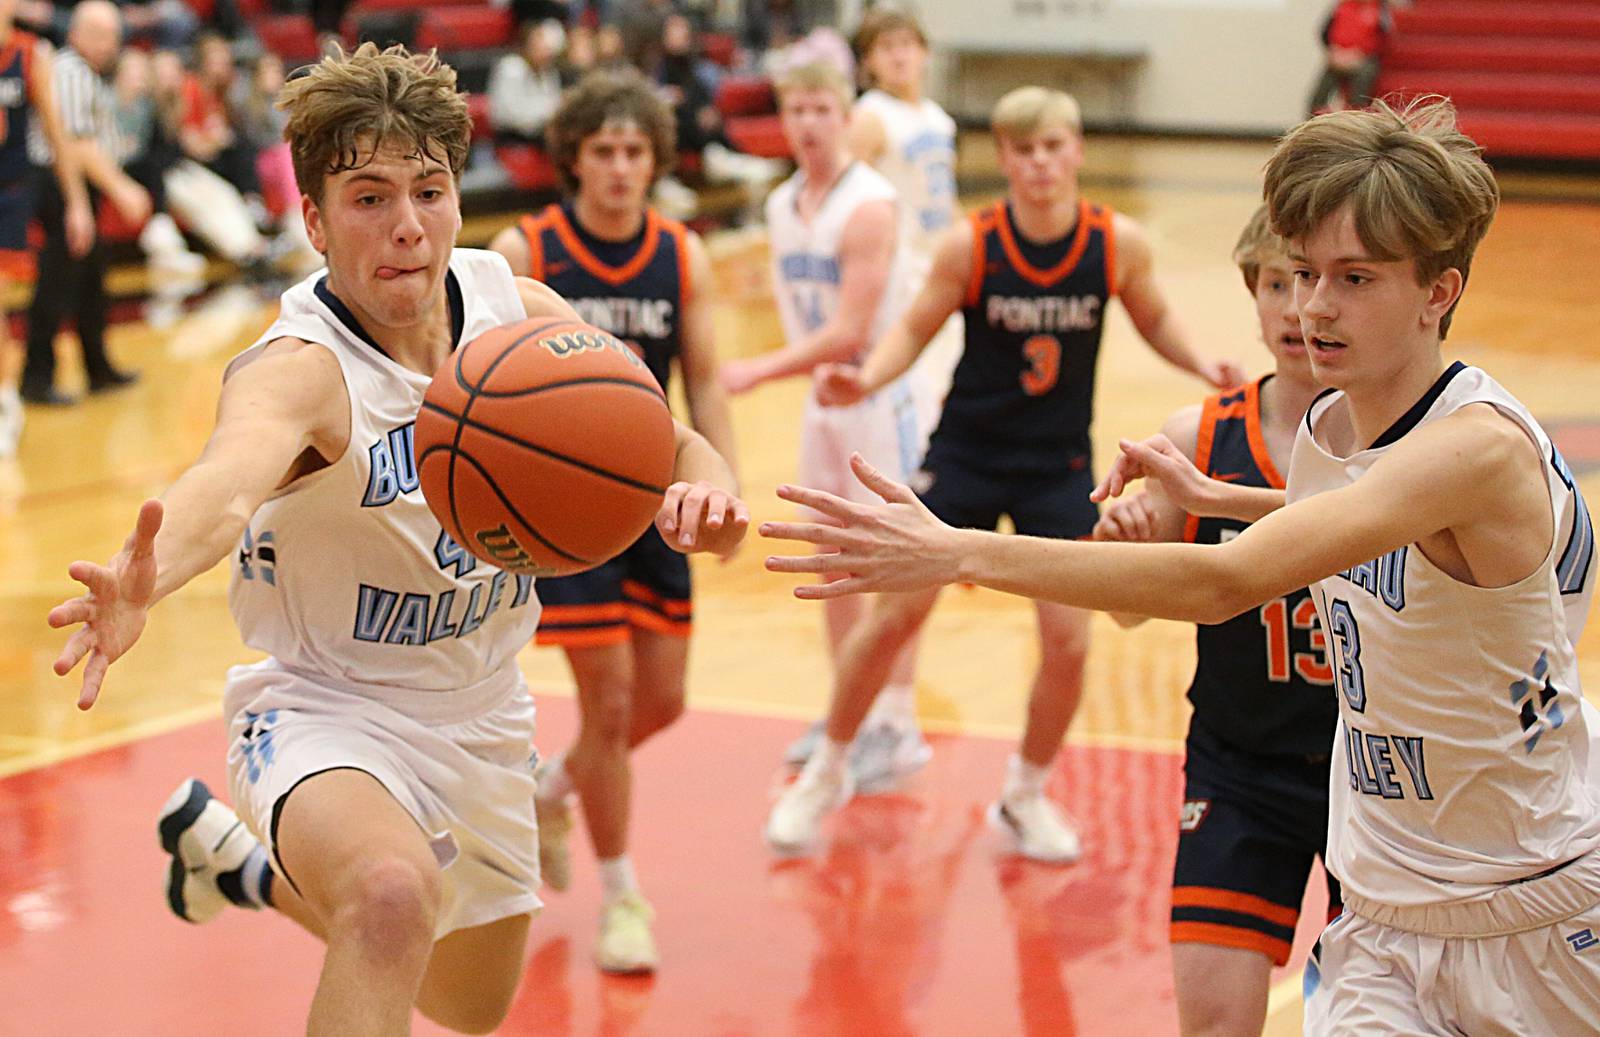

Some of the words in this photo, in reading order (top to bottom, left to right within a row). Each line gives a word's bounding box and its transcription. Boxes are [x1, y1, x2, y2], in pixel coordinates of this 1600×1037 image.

[986, 294, 1099, 332] PONTIAC
[1020, 334, 1061, 396] 3
[353, 570, 533, 645] VALLEY
[1260, 597, 1335, 686] 13
